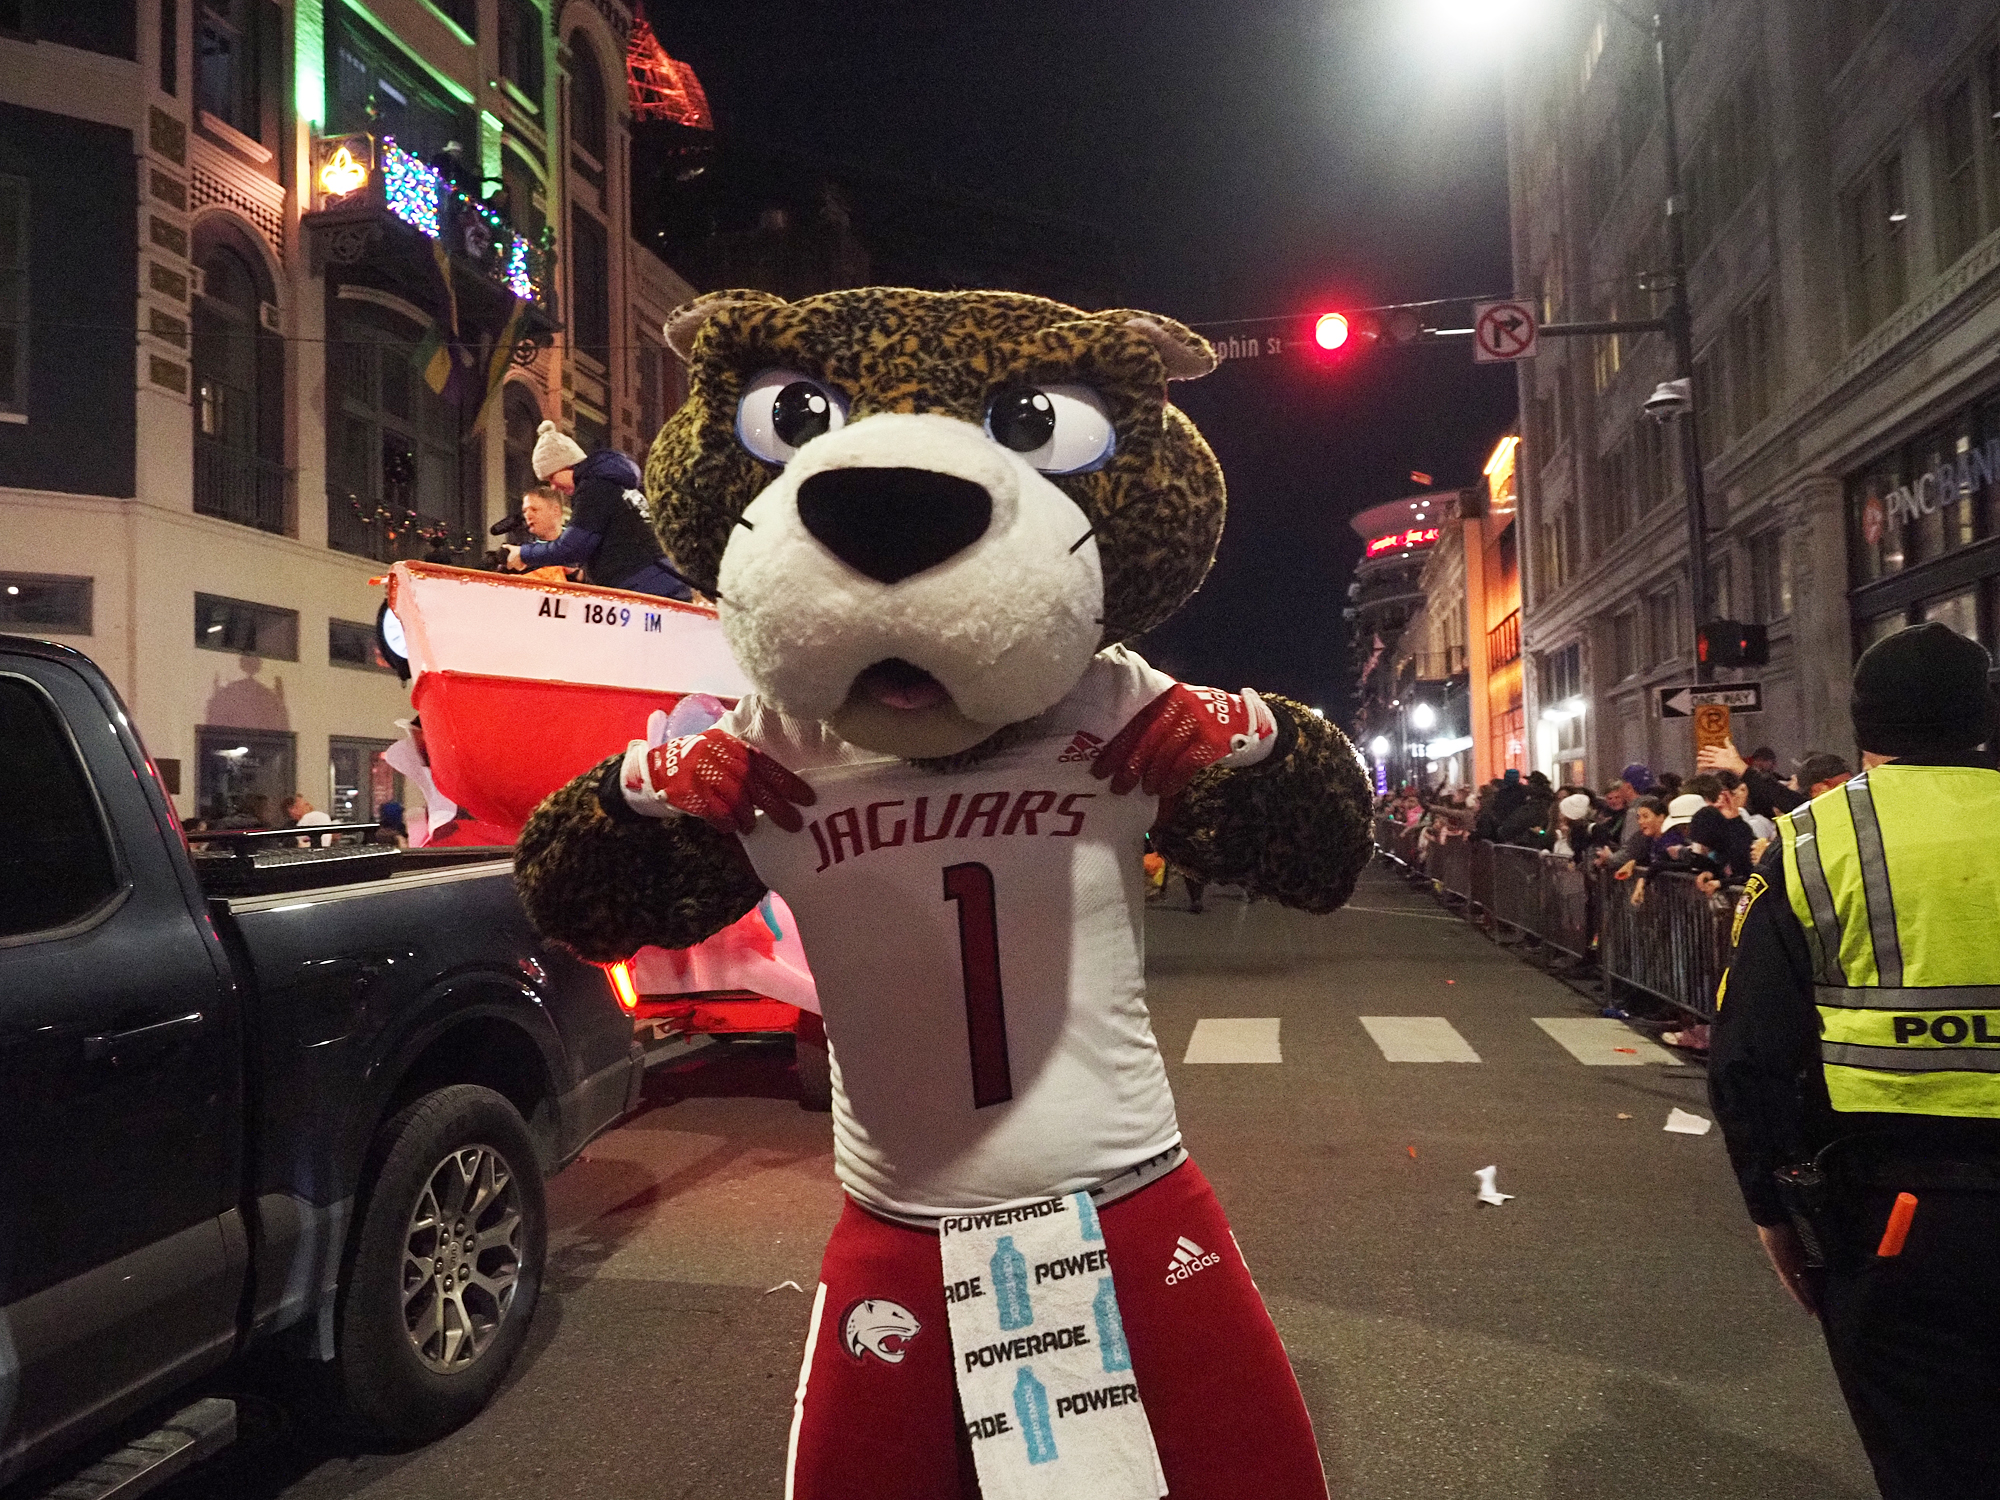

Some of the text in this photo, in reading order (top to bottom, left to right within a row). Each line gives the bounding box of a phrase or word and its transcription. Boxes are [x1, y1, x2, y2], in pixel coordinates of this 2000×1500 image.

[1267, 337, 1282, 355] St
[1885, 472, 1936, 532] PNC
[538, 597, 567, 619] AL
[584, 603, 631, 627] 1869
[1209, 687, 1230, 725] adid
[1722, 691, 1751, 704] WAY
[1058, 746, 1102, 763] adid
[809, 790, 1096, 873] JAGUARS
[942, 861, 1013, 1109] 1
[1893, 1015, 2000, 1044] POL
[1165, 1252, 1220, 1286] adidas
[1056, 1383, 1138, 1418] POWER
